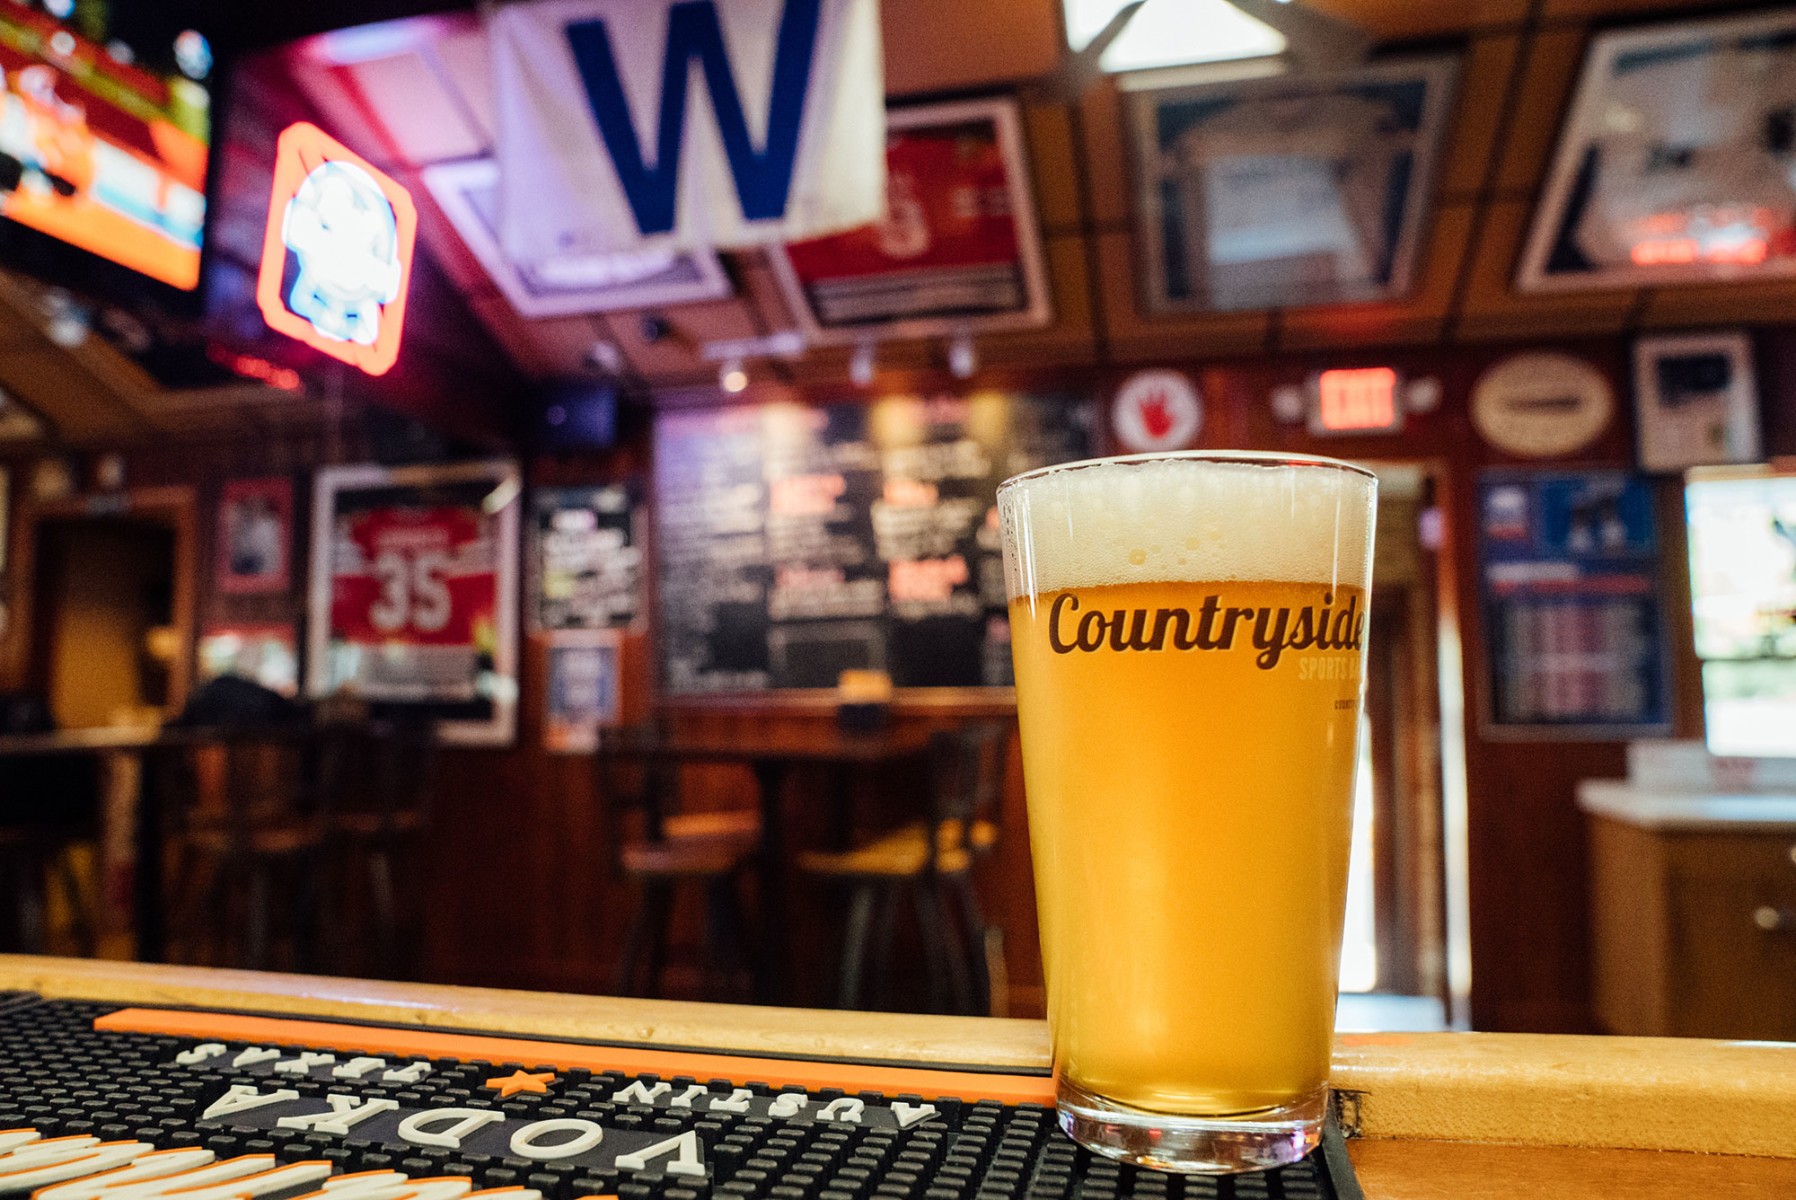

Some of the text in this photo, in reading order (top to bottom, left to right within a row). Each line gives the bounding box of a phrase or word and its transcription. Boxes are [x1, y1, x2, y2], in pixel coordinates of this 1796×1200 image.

[566, 0, 821, 234] W
[368, 549, 452, 632] 35
[1048, 592, 1364, 670] Countryside
[1299, 656, 1346, 680] SPORTS
[175, 1043, 936, 1128] AUSTIN TEXAS
[202, 1085, 707, 1176] VODKA
